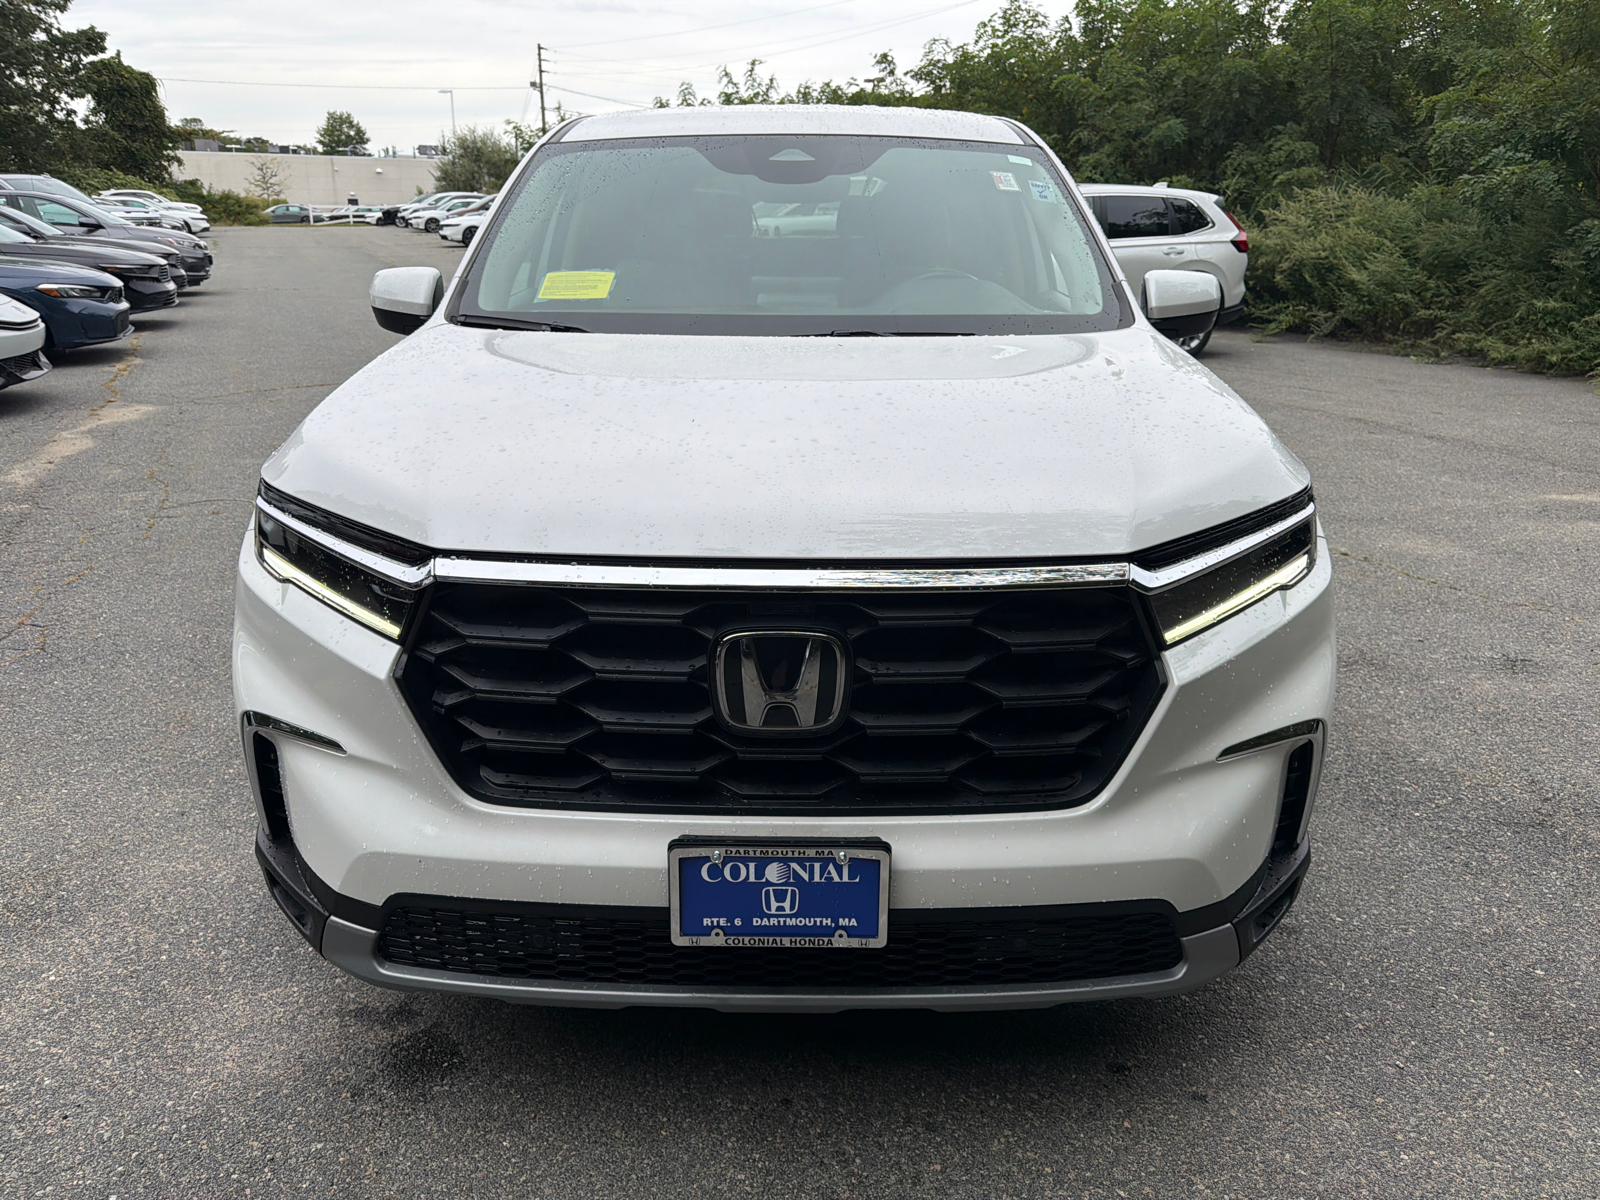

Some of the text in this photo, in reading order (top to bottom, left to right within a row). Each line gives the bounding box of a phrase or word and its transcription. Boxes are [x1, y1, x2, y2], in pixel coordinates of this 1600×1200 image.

[701, 862, 860, 883] COLONIAL
[703, 917, 858, 927] RTE. 6 DARTMOUTH, MA
[725, 938, 834, 947] COLONIAL HONDA
